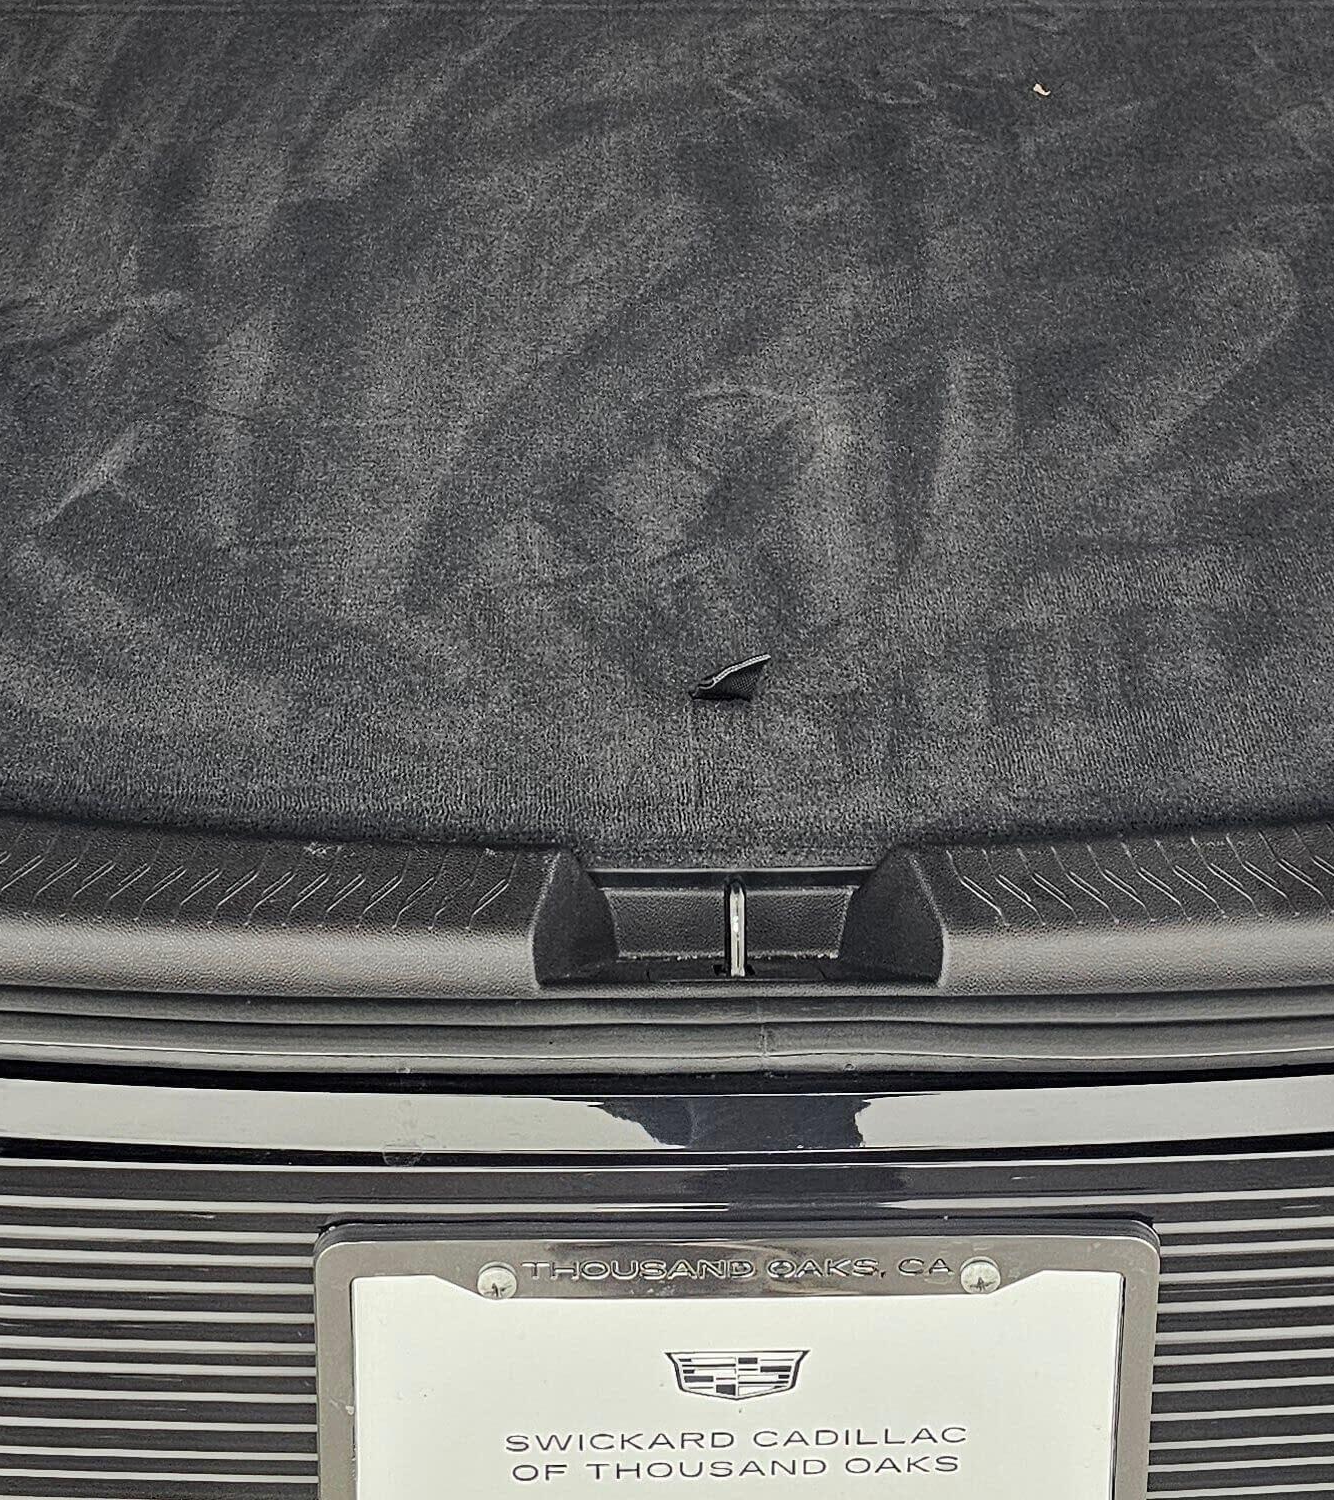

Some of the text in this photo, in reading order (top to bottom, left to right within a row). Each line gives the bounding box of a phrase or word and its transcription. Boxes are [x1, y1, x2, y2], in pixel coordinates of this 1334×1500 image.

[521, 1258, 956, 1280] THOUSAND OAKS, CA
[505, 1426, 967, 1452] SWICKARD CADILLAC
[511, 1455, 960, 1482] OF THOUSAND OAKS
